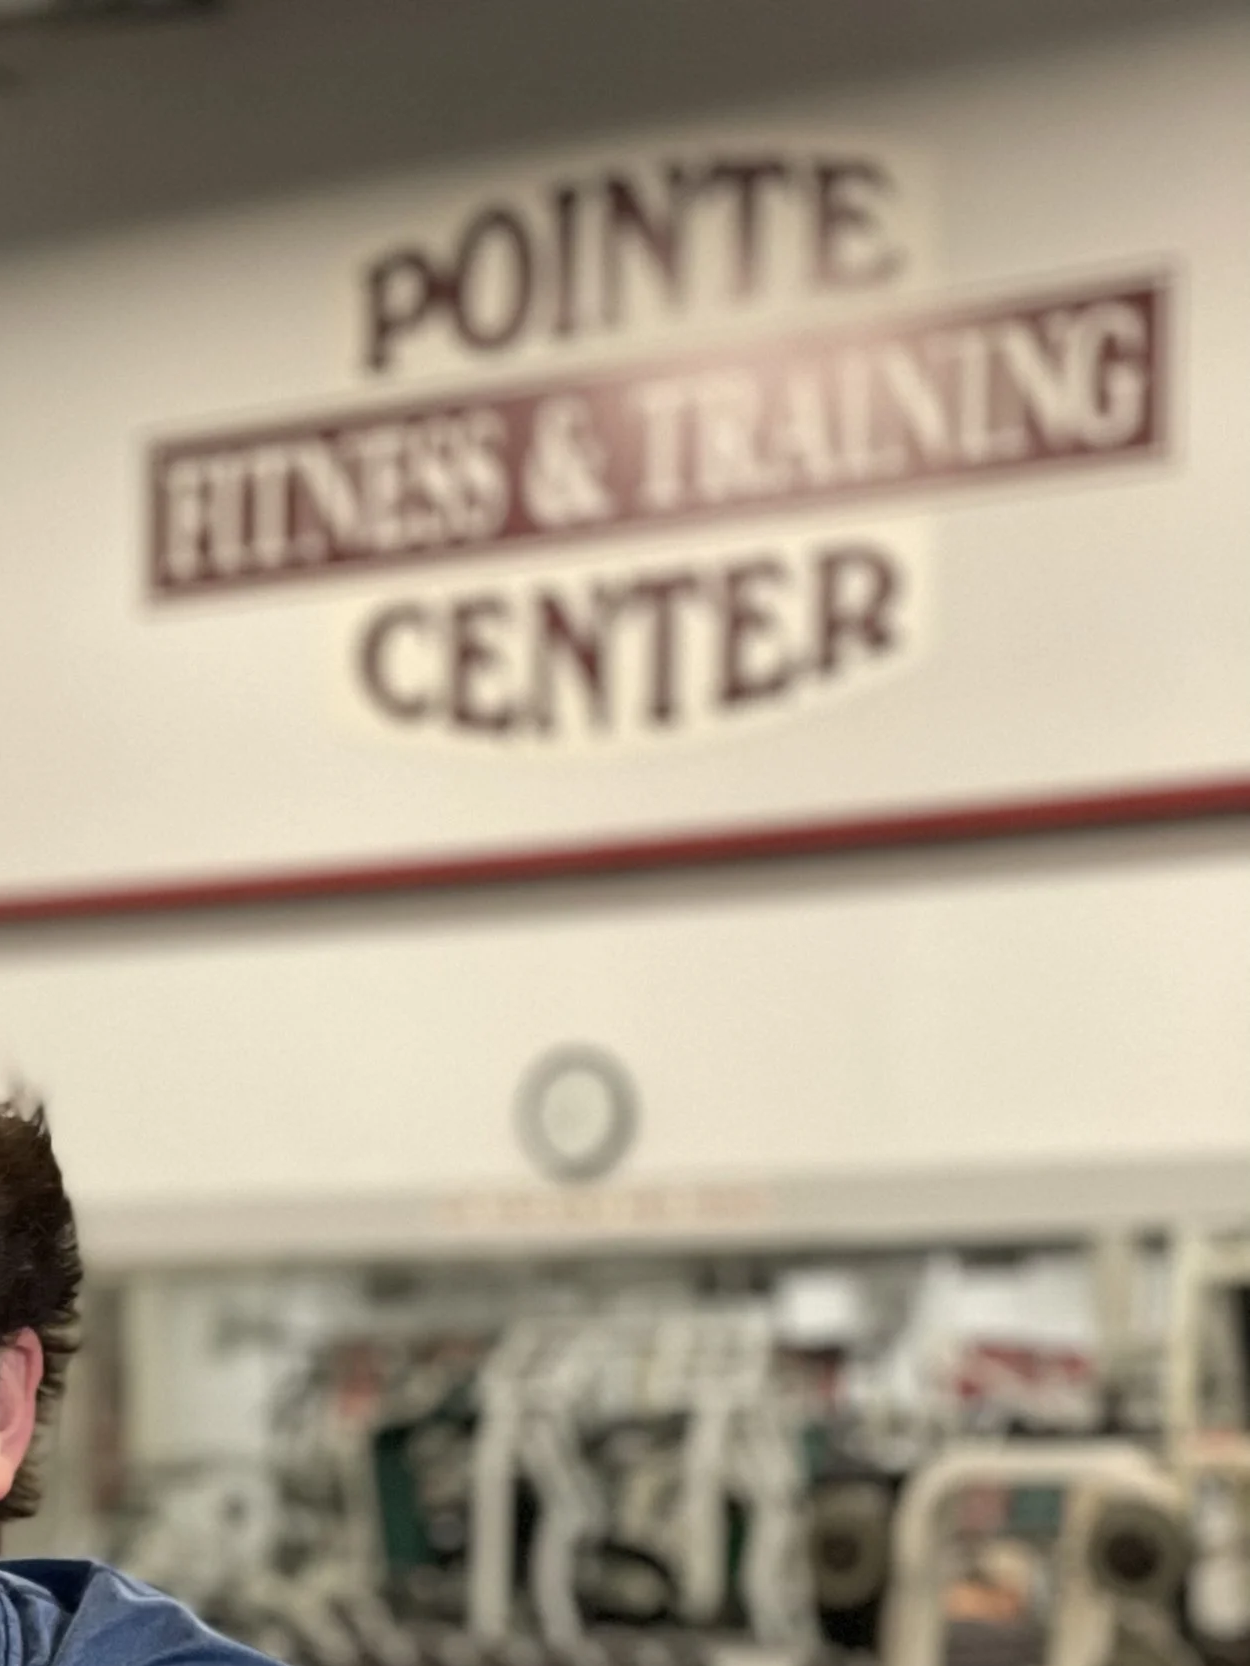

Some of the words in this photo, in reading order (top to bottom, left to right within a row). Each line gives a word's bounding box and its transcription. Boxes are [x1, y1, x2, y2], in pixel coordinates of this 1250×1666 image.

[363, 152, 904, 372] POINTE
[161, 408, 510, 584] FITNESS
[520, 396, 616, 532] &
[638, 300, 1150, 508] TRAINING
[357, 538, 902, 738] CENTER
